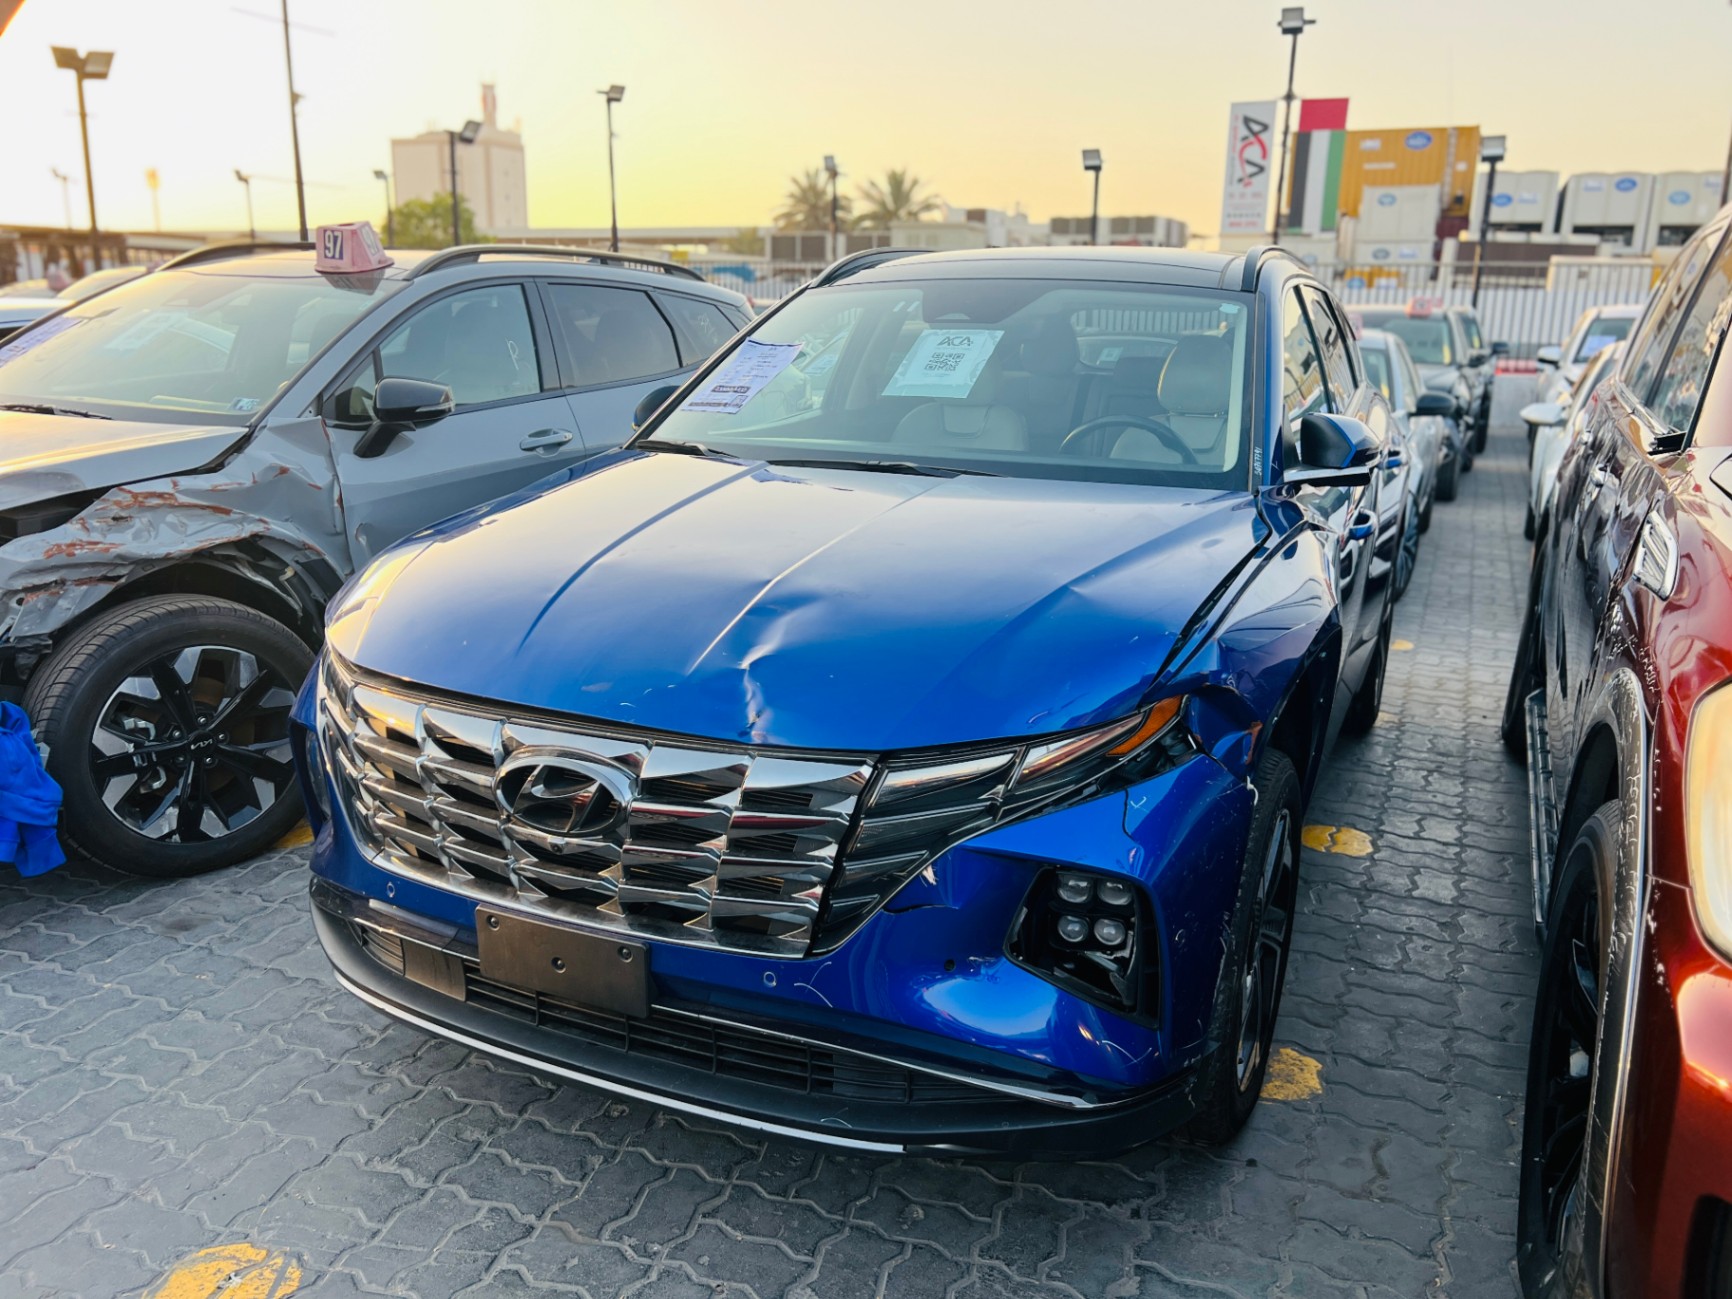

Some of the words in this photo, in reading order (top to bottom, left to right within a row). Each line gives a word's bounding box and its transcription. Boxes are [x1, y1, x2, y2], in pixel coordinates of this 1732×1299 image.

[1237, 115, 1269, 183] ACA
[324, 230, 342, 259] 97
[936, 336, 971, 347] ACA
